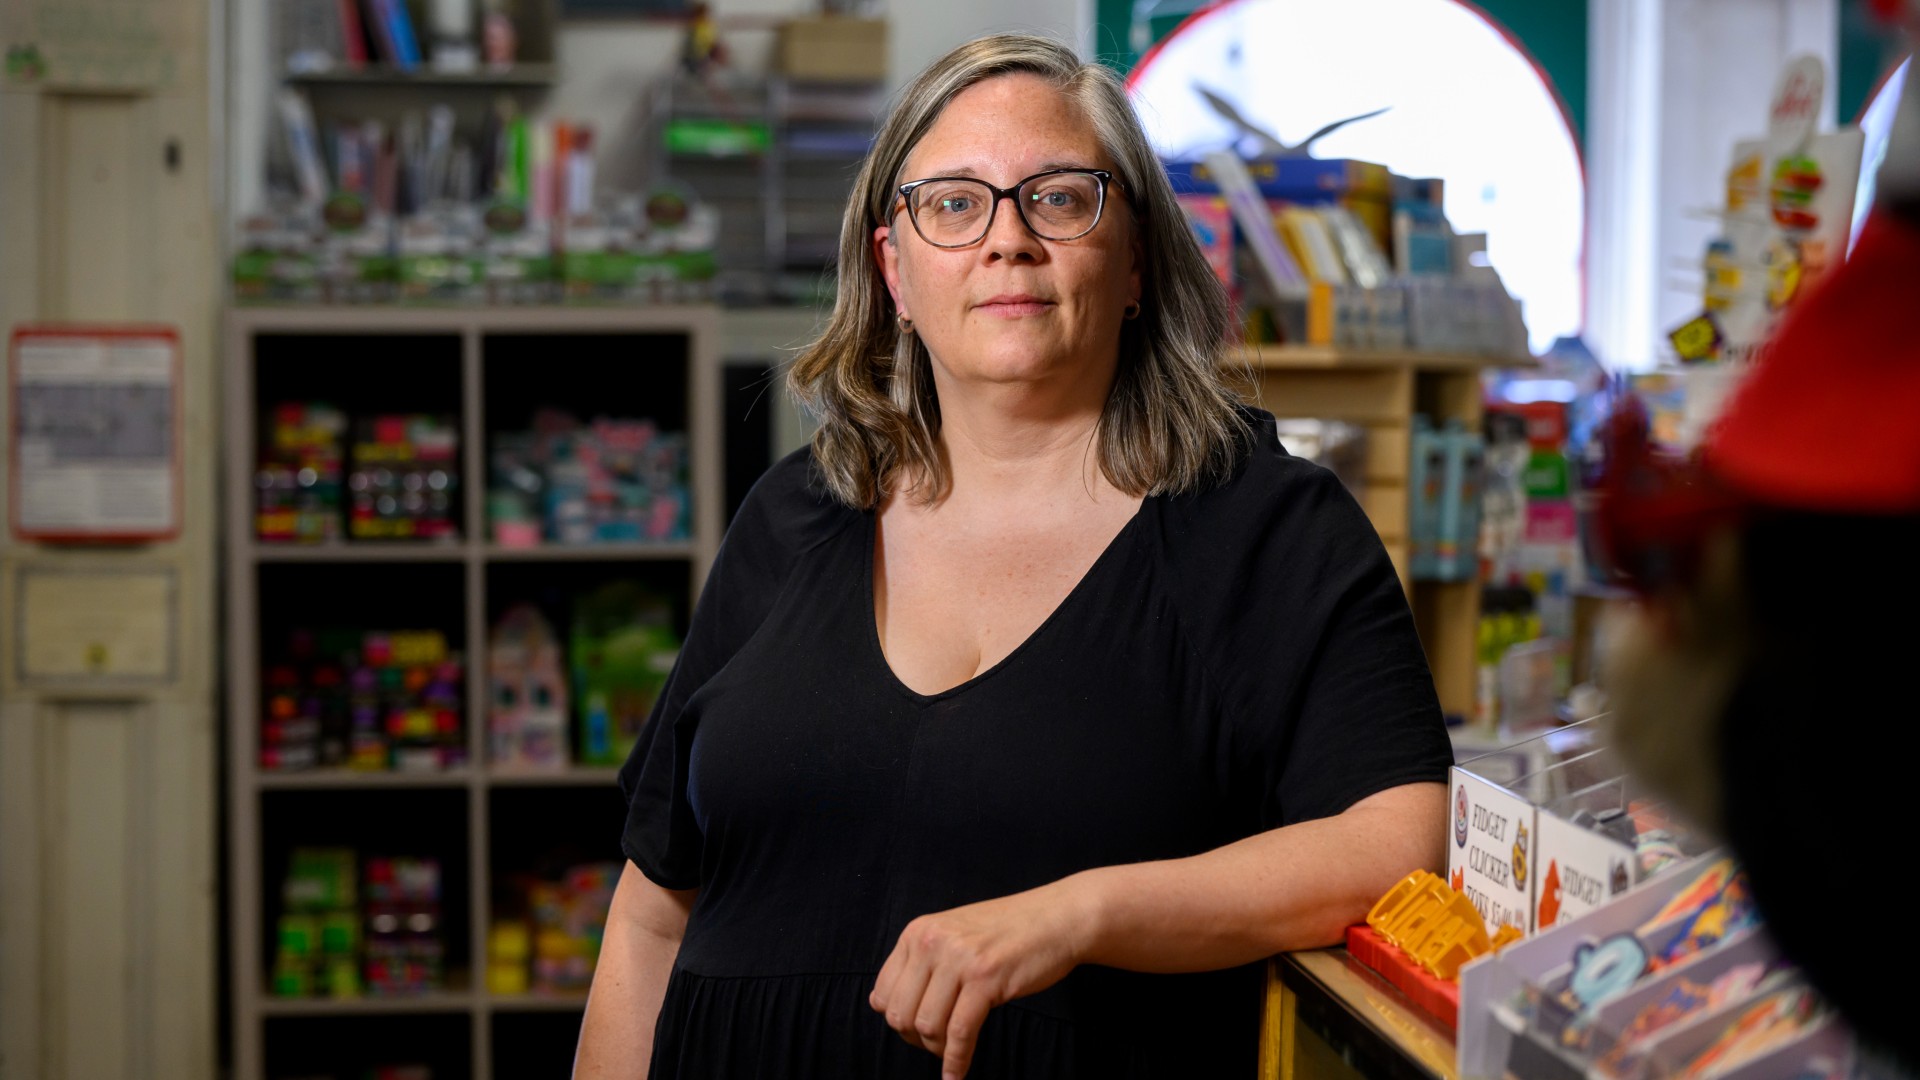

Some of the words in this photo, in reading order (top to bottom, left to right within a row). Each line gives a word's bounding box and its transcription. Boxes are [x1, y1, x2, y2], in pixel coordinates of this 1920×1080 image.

[1472, 803, 1508, 843] FIDGET
[1469, 845, 1509, 890] CLICKER
[1563, 865, 1604, 908] FIDGET
